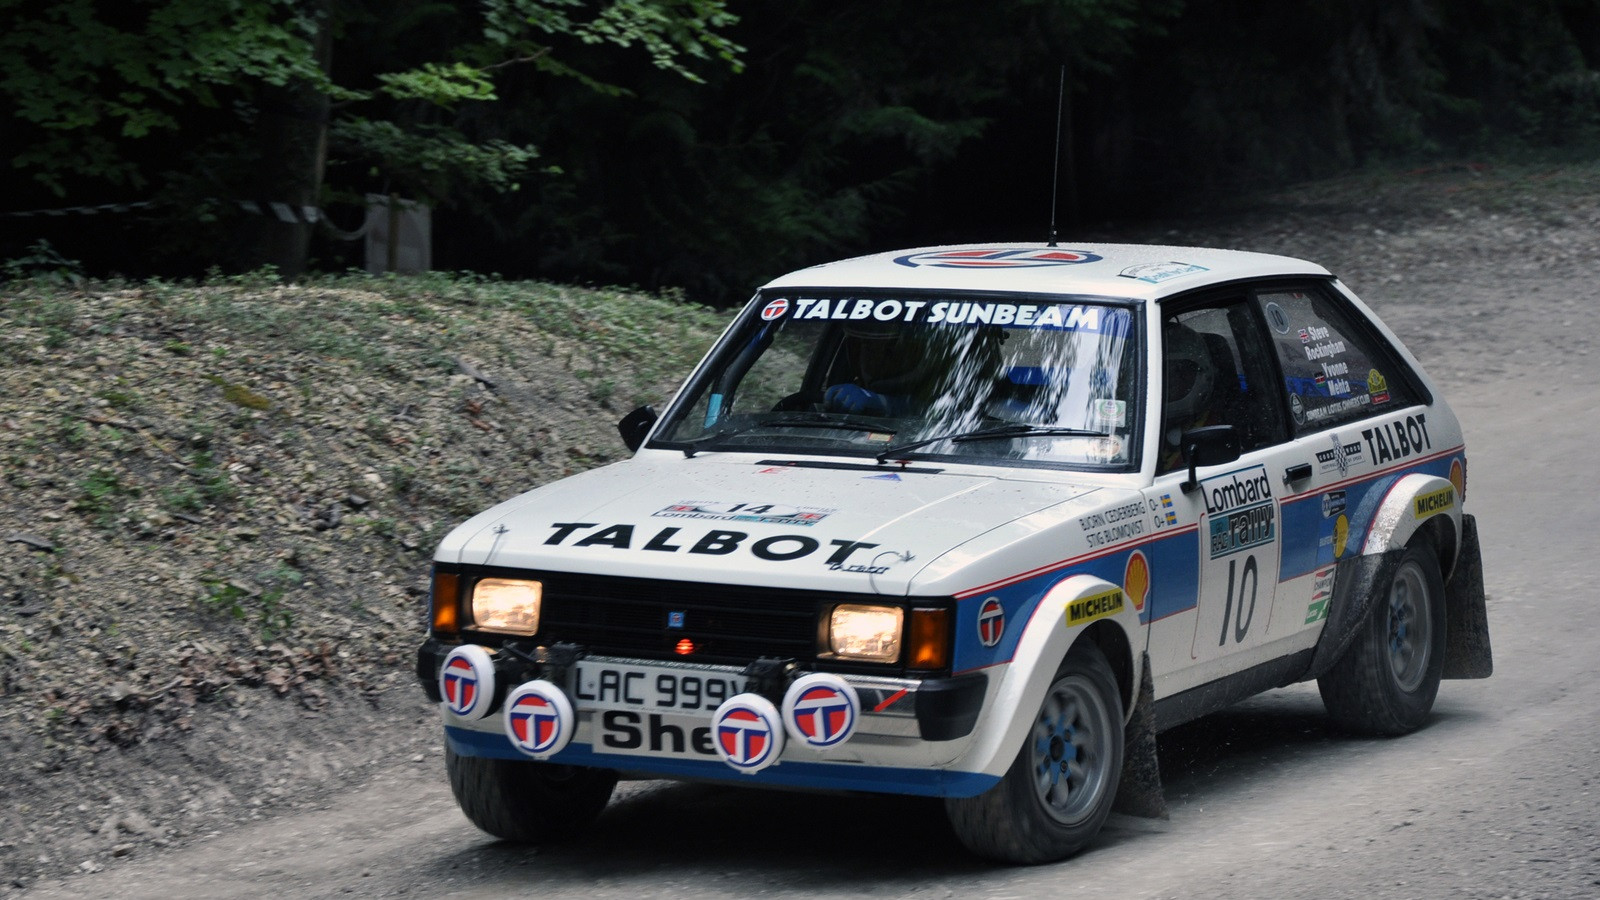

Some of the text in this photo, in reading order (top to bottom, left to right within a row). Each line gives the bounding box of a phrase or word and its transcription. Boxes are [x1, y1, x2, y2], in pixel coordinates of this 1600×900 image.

[793, 299, 1098, 330] TALBOT SUNBEAM
[1271, 311, 1284, 327] 10
[1309, 327, 1330, 341] Steve
[1305, 340, 1346, 361] Rockingham
[1322, 361, 1349, 378] Yvonne
[1361, 413, 1431, 466] TALBOT
[1200, 468, 1272, 514] Lombard
[1417, 489, 1454, 514] MICHELIN
[650, 511, 737, 521] Lombard
[726, 503, 775, 514] 14
[1105, 501, 1146, 523] CEDERBERG
[1086, 531, 1104, 548] STIG
[1230, 505, 1272, 548] rally
[542, 522, 880, 566] TALBOT
[1070, 591, 1123, 622] MICHELIN
[1219, 554, 1258, 647] 10
[575, 667, 646, 705] LAC
[602, 710, 719, 755] She
